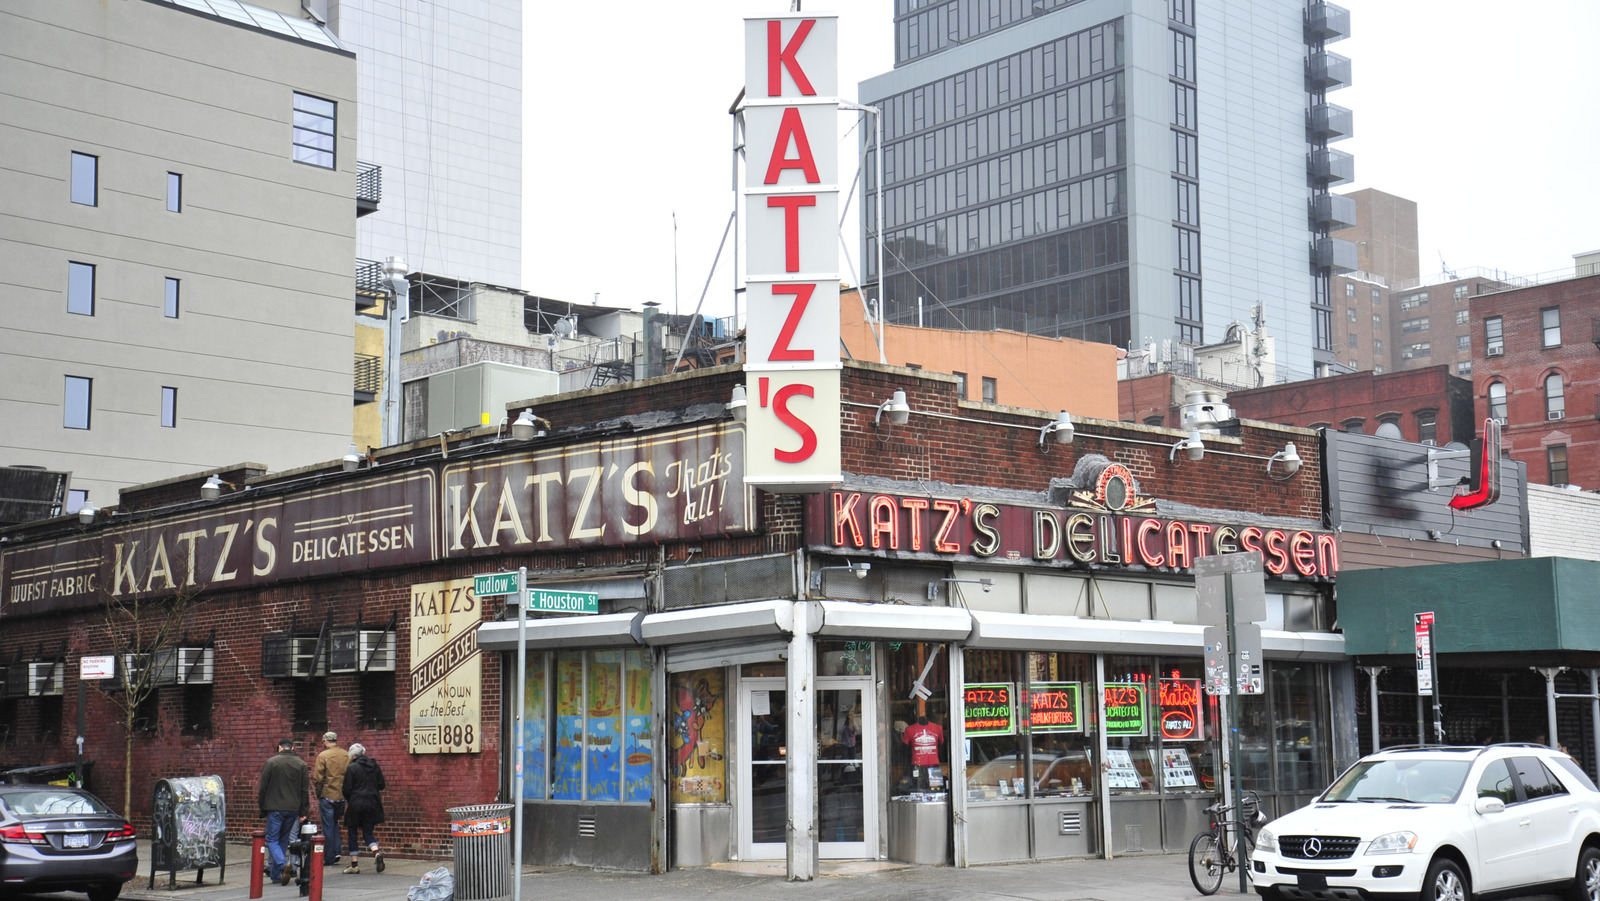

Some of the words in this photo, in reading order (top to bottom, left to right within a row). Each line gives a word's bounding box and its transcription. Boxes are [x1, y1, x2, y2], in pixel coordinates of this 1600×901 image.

[759, 19, 820, 464] KATZ'S
[665, 447, 732, 498] That's
[449, 461, 659, 551] KATZ'S
[292, 524, 414, 563] DELICATESSEN
[832, 492, 1001, 558] KATZ'S
[1033, 508, 1339, 577] DELICATESSEN
[112, 517, 278, 597] KATZ'S
[50, 573, 96, 598] FABRIC
[475, 576, 509, 595] Ludlow
[511, 575, 518, 585] St
[414, 586, 475, 617] KATZ'S
[530, 592, 536, 608] E
[540, 592, 585, 610] Houston
[588, 595, 596, 605] St
[411, 627, 478, 696] DELICATESSEN
[437, 685, 472, 698] KNOWN
[1032, 691, 1068, 710] KATZ'S
[1105, 687, 1137, 704] ATZ'S
[419, 709, 429, 718] as
[430, 701, 444, 718] the
[444, 700, 465, 716] Best
[413, 733, 437, 746] SINCE
